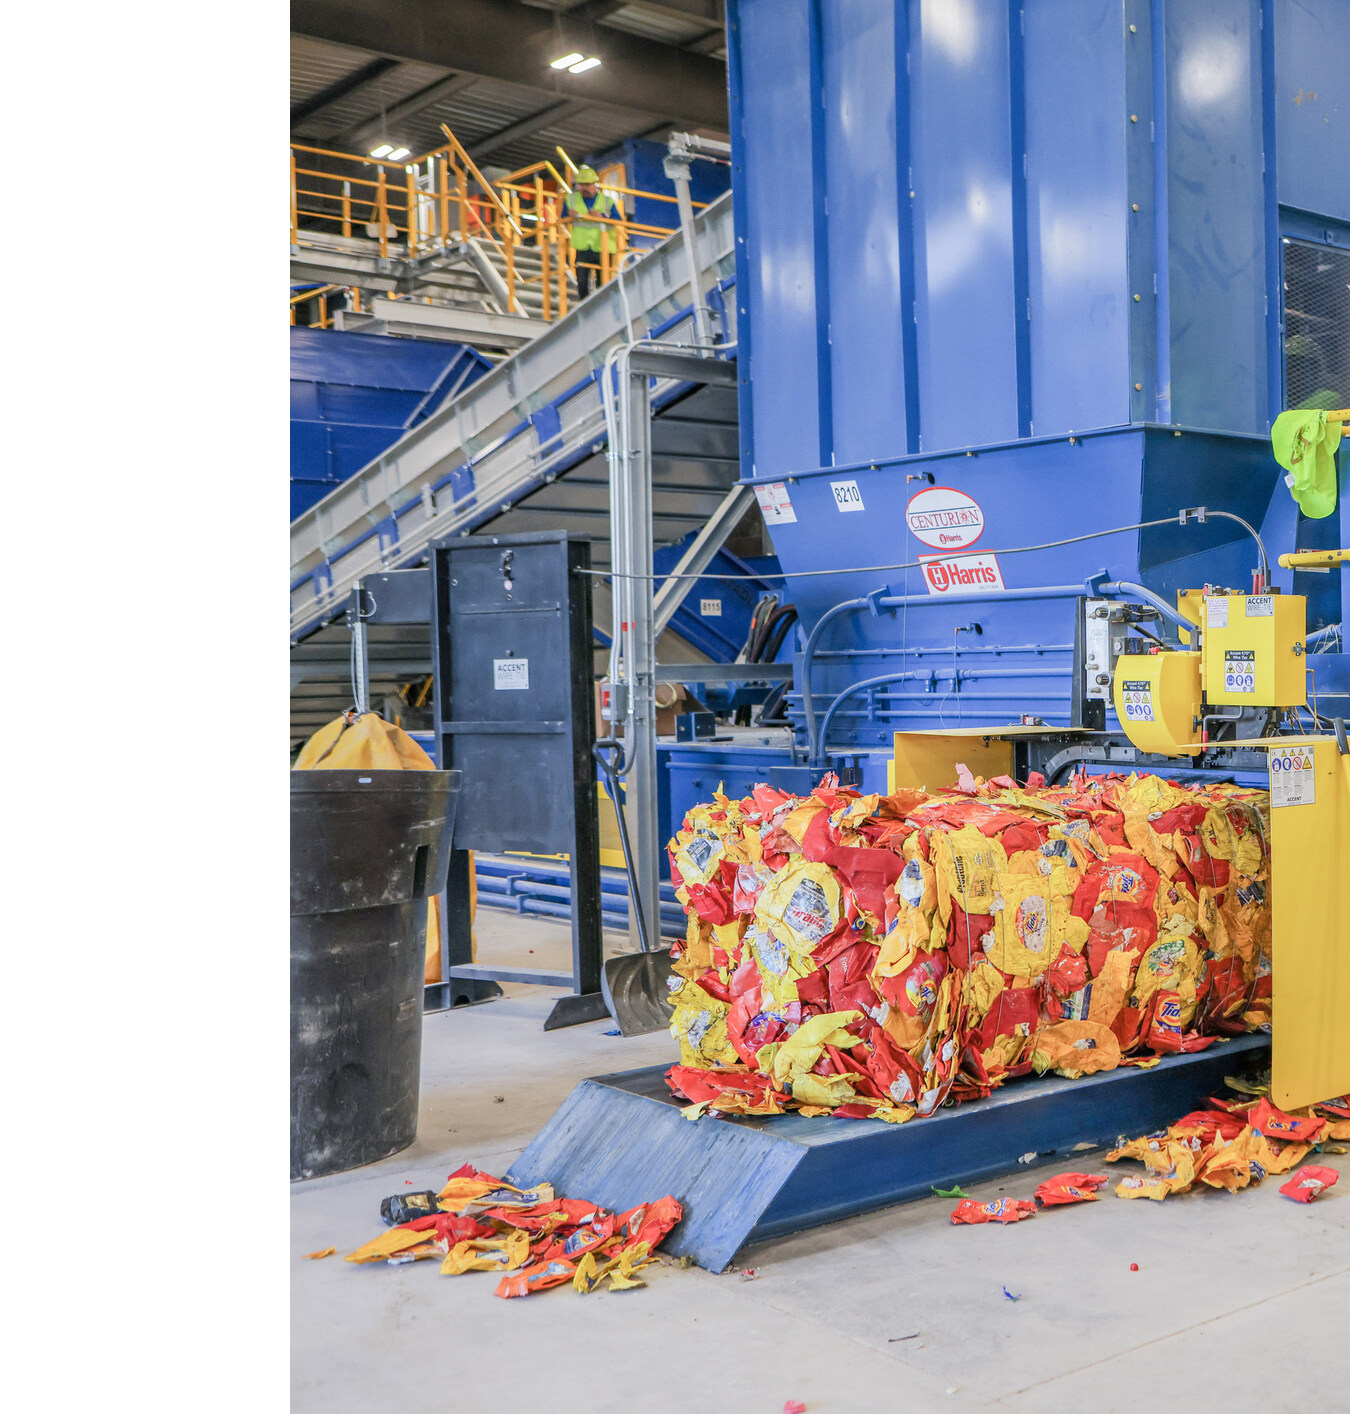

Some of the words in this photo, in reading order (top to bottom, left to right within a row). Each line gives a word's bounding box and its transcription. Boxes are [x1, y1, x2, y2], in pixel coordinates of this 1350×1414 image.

[834, 486, 860, 503] 8210
[947, 561, 996, 585] Harris
[703, 602, 720, 611] 8115
[1247, 597, 1271, 605] ACCENT
[498, 664, 525, 672] ACCENT
[1120, 873, 1134, 893] Tide
[1026, 913, 1036, 932] Tide
[1161, 1001, 1181, 1018] Tid
